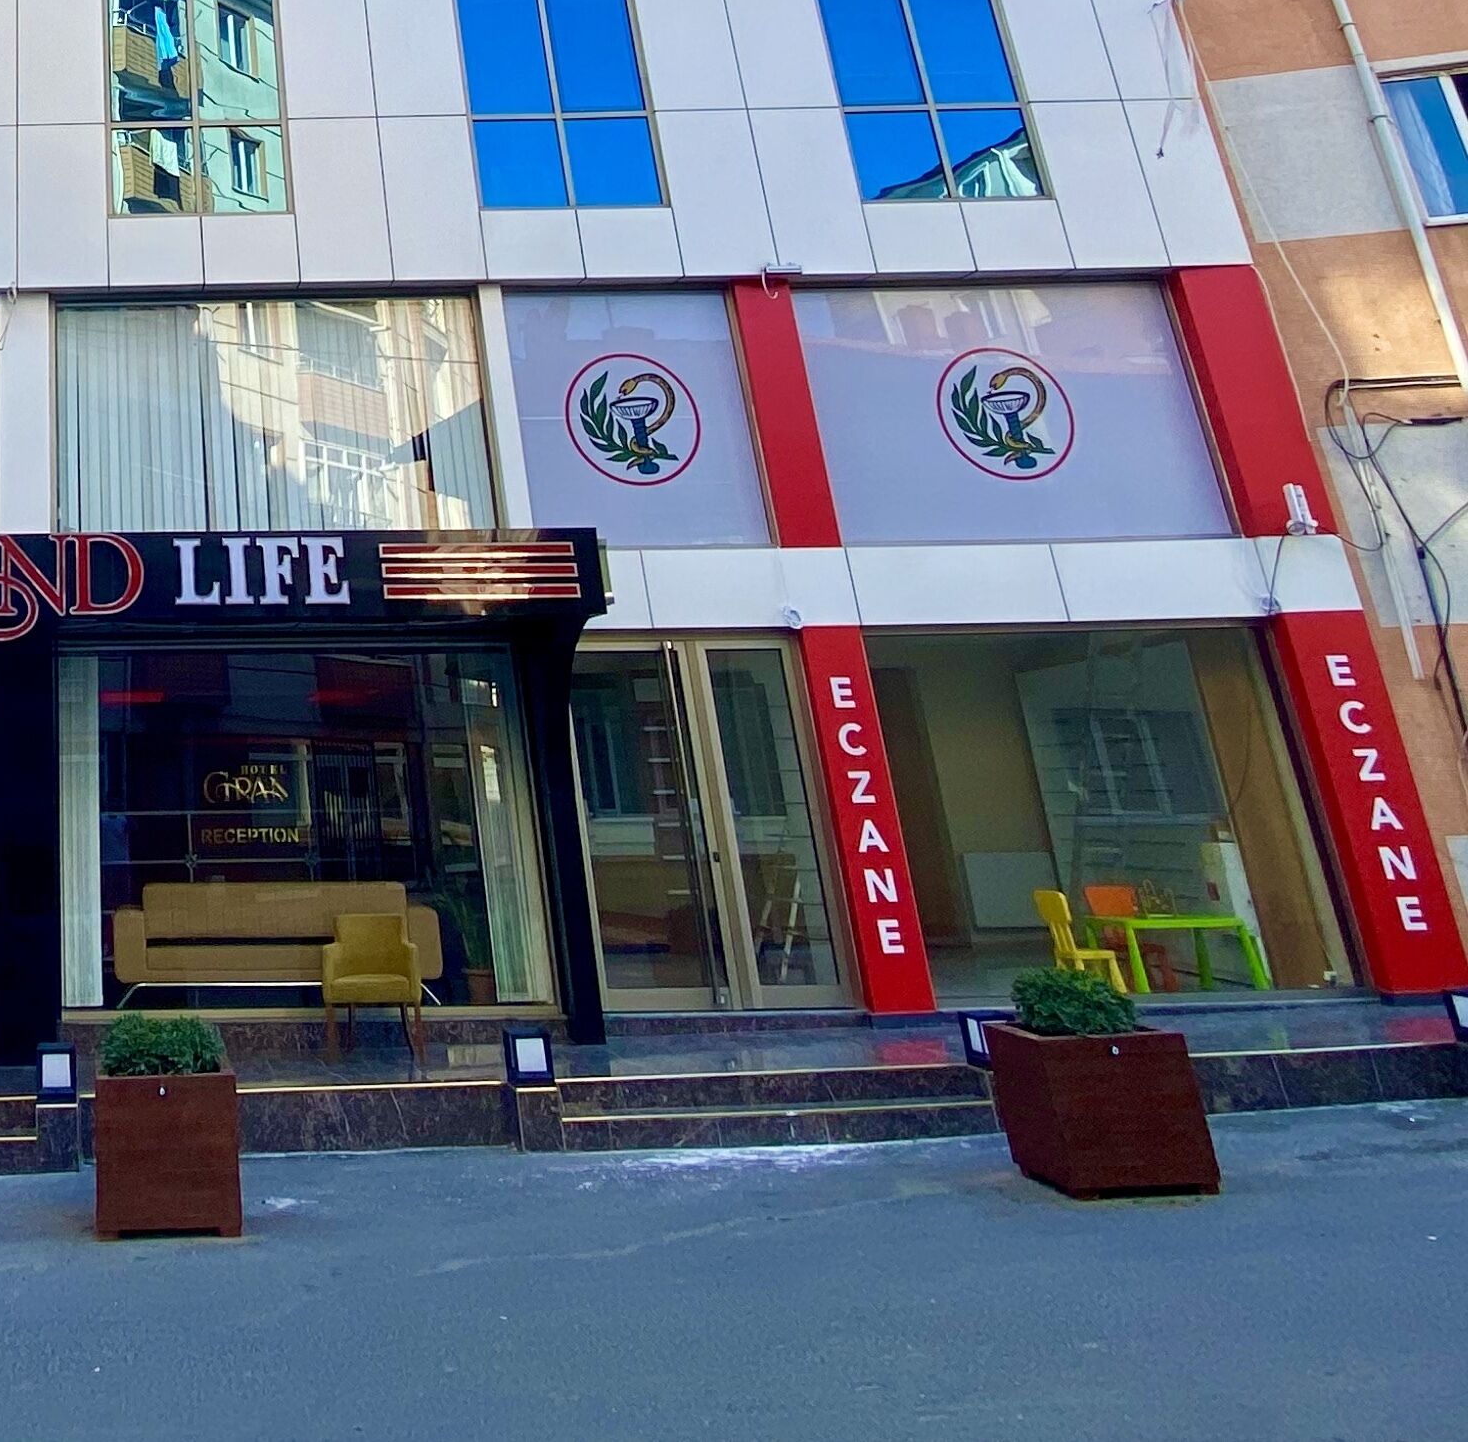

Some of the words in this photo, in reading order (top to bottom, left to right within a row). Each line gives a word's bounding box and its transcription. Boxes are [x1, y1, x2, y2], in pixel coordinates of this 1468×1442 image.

[172, 536, 351, 606] LIFE
[240, 764, 287, 775] HOTEL
[1326, 654, 1428, 931] ECZANE
[200, 827, 300, 844] RECEPTION
[829, 676, 905, 954] ECZANE
